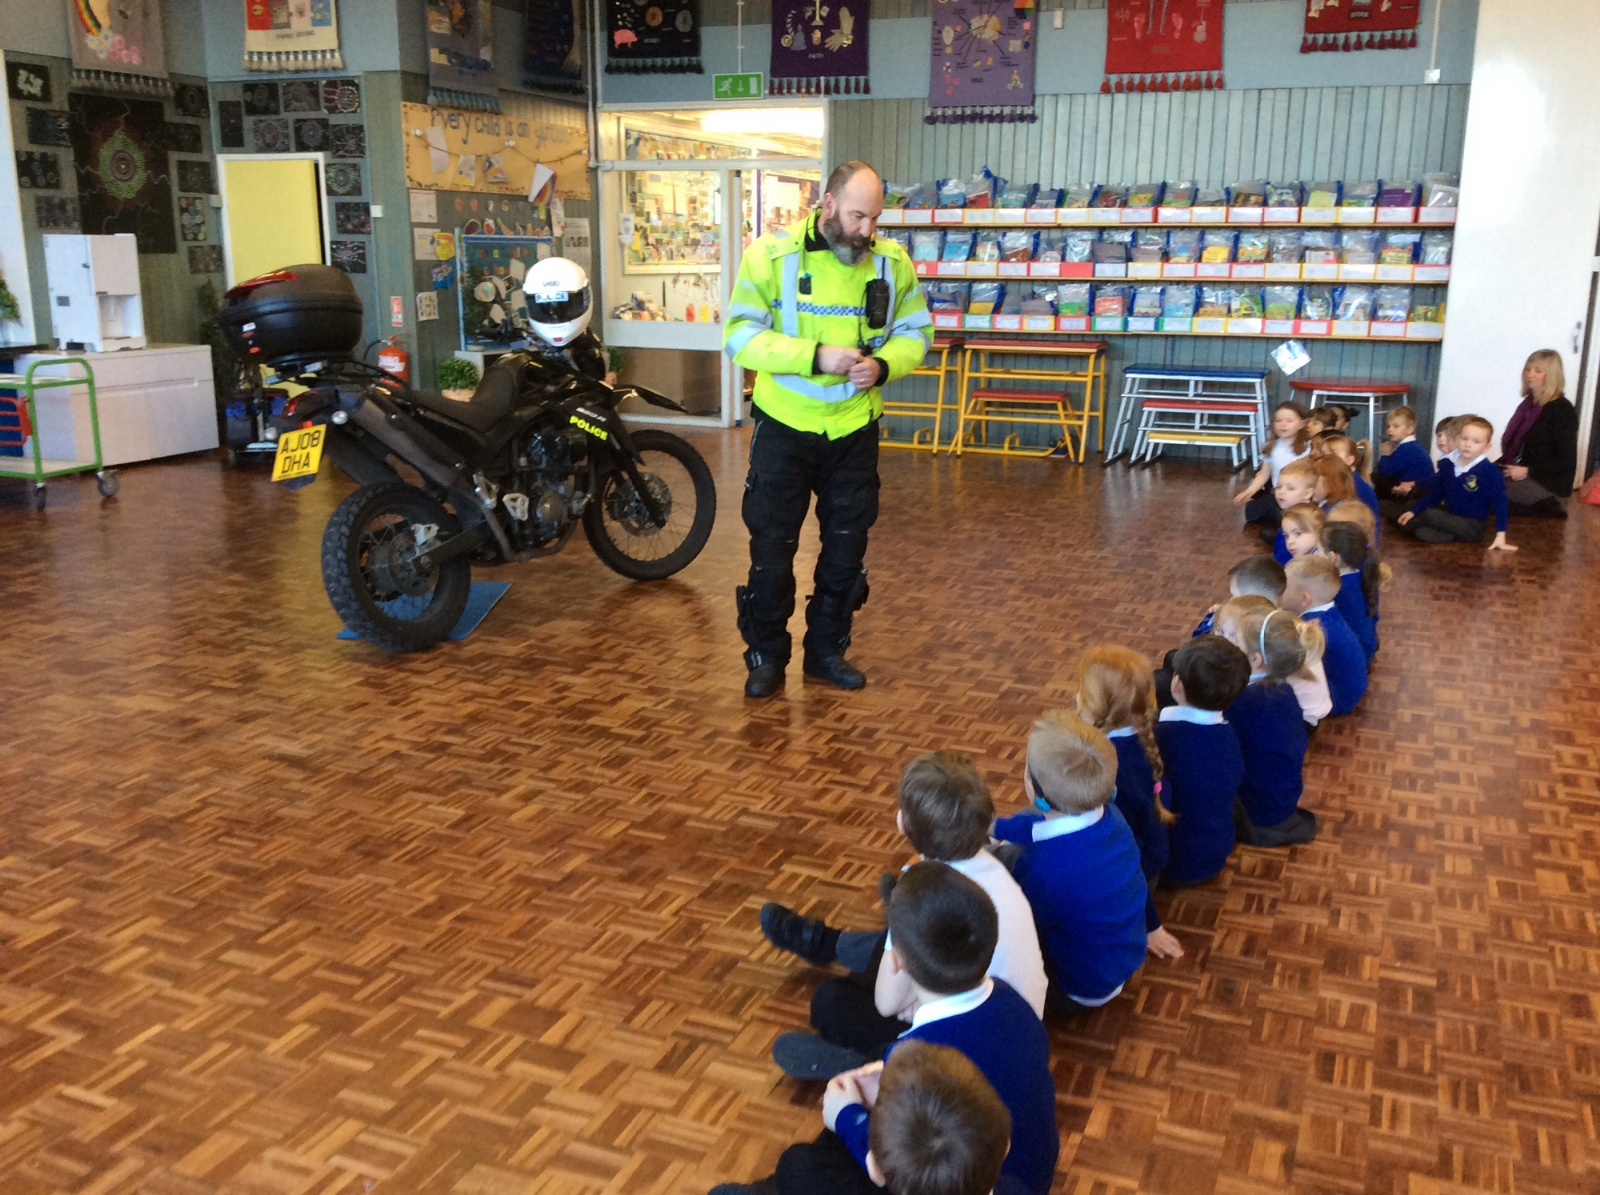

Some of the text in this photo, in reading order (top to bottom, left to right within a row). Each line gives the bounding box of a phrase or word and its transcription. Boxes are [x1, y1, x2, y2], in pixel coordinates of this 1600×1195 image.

[536, 293, 566, 301] PLCE
[569, 415, 608, 441] POLICE
[281, 452, 310, 474] DHA
